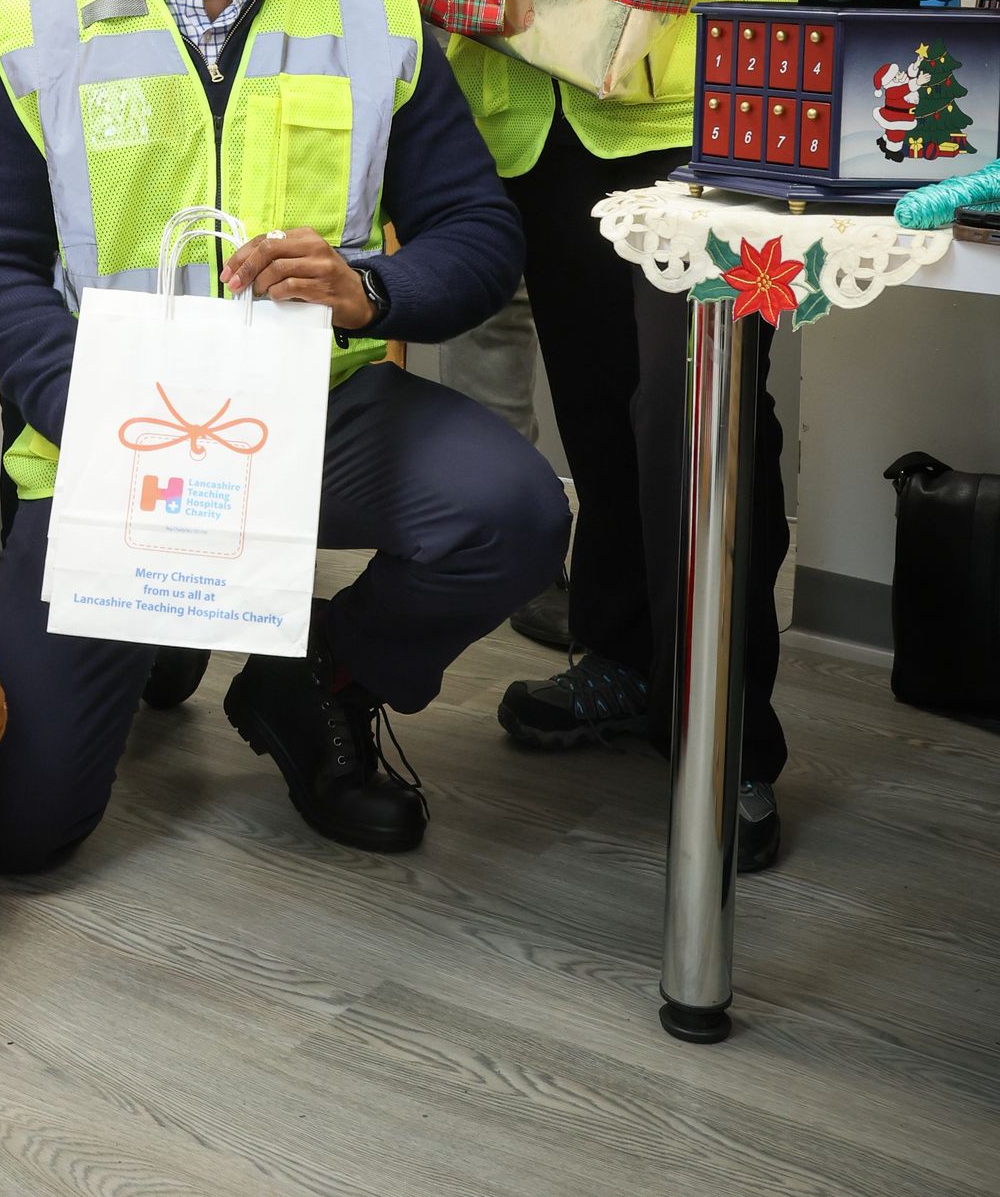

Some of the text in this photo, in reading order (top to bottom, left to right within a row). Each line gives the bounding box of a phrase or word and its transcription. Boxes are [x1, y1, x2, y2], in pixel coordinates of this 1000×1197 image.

[715, 55, 822, 75] 1 2 3 4
[712, 127, 818, 152] 5 6 7 8
[188, 478, 241, 492] Lancashire
[187, 488, 231, 501] Teaching
[186, 498, 232, 510] Hospitals
[185, 507, 222, 520] Charity
[135, 567, 227, 587] Merry Christmas
[143, 584, 215, 602] from us all at
[73, 593, 284, 626] Lancashire Teaching Hospitals Charity
